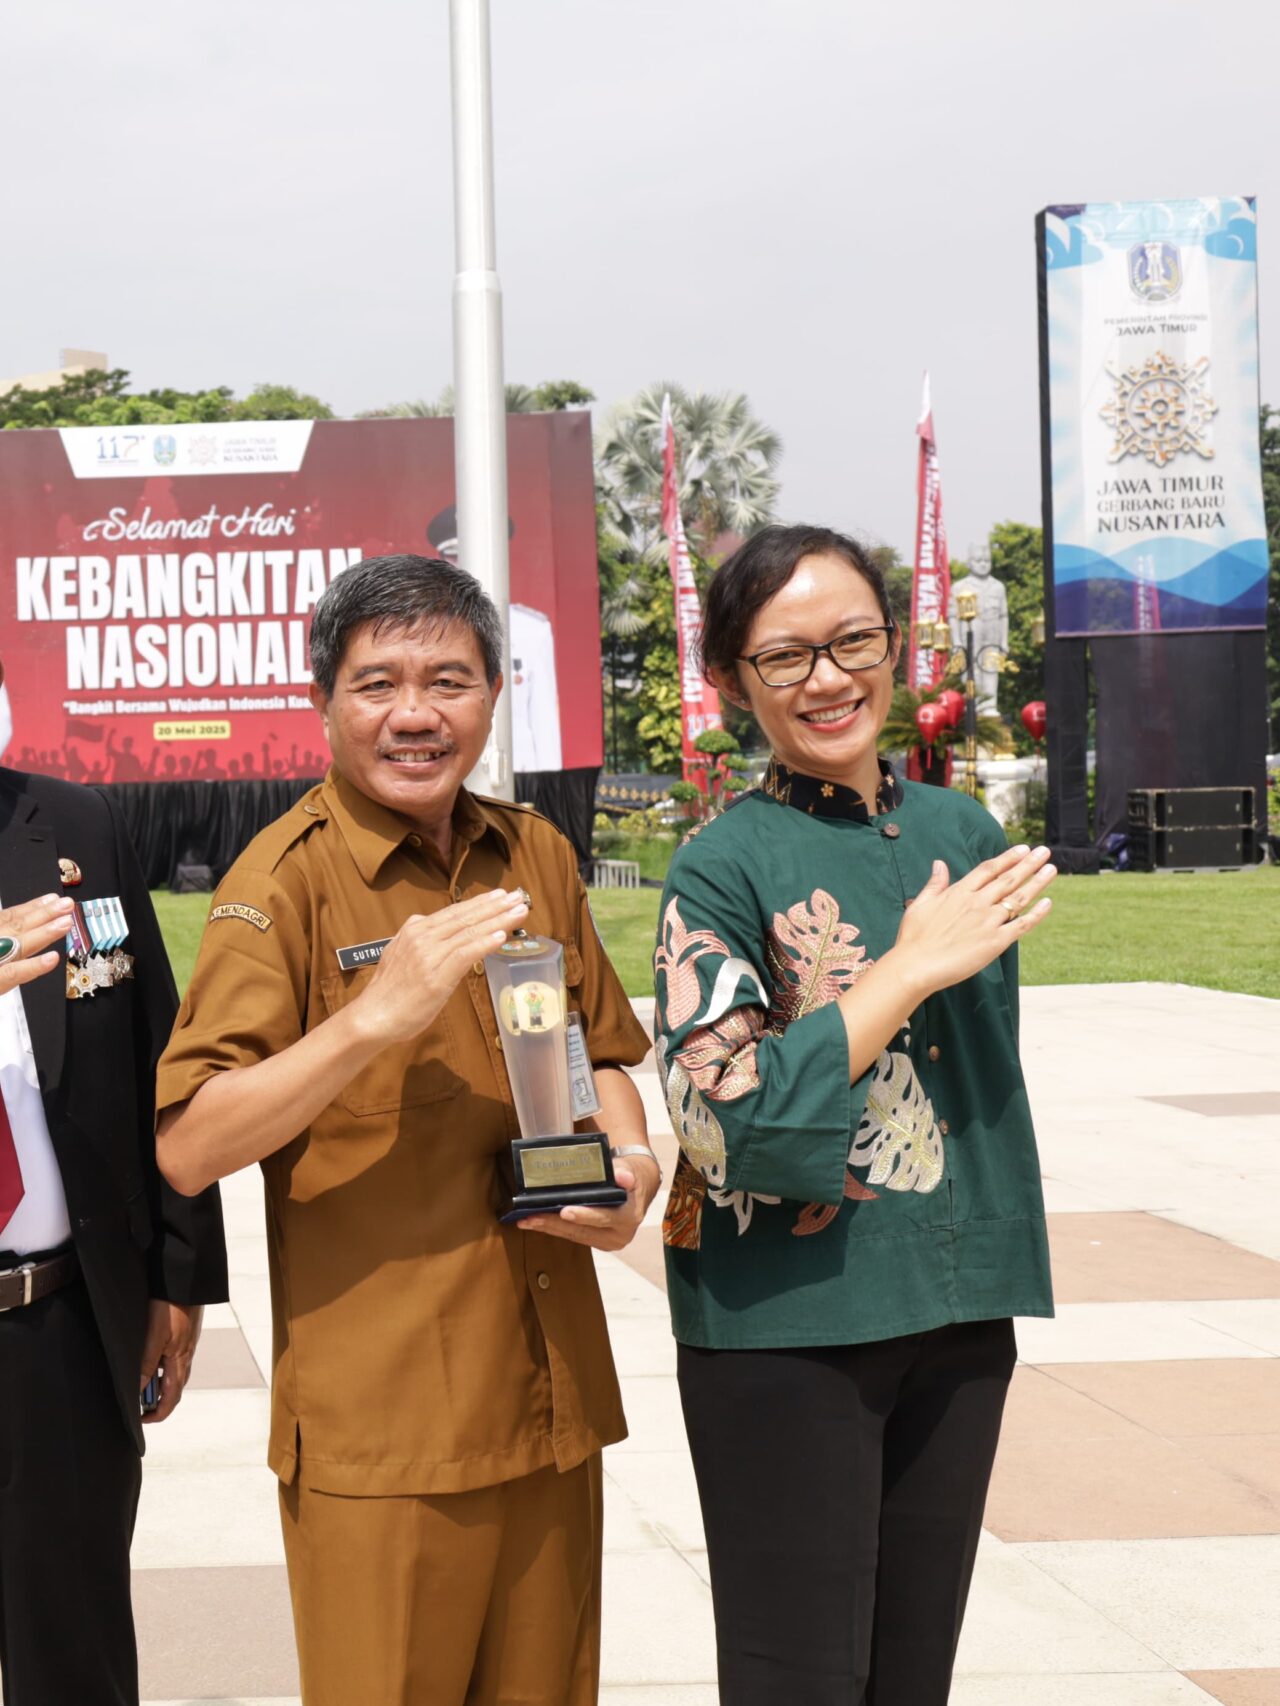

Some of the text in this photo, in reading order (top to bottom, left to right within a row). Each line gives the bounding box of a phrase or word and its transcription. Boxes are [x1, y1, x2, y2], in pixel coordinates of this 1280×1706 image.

[1097, 475, 1224, 496] JAWA TIMUR
[1097, 495, 1226, 513] GERBANG BARU
[83, 503, 297, 541] Selamat Hari
[1098, 512, 1226, 534] NUSANTARA
[66, 620, 315, 690] NASIONAL
[116, 700, 167, 713] Bersama
[169, 698, 227, 713] Wujudkan
[229, 697, 286, 711] Indonesia
[158, 724, 227, 736] 20 Mei 2025
[352, 946, 385, 962] SUTRIS
